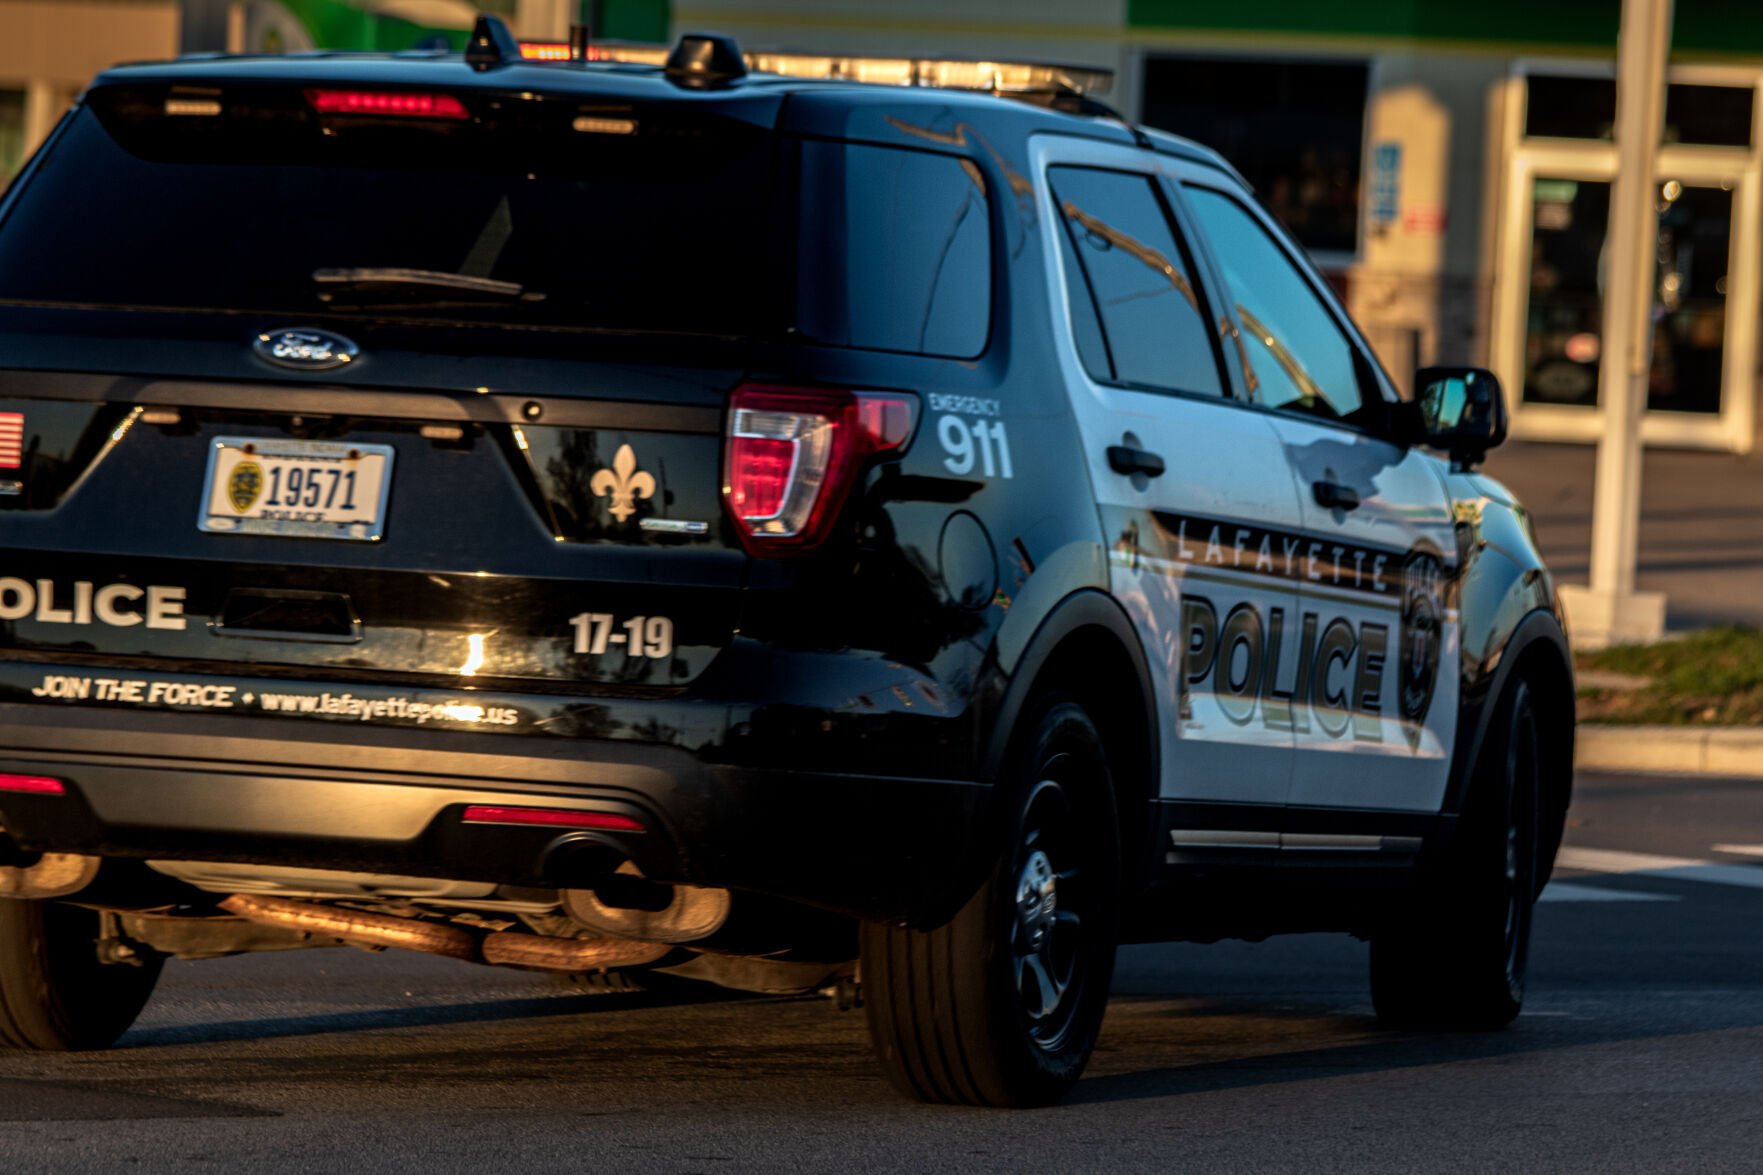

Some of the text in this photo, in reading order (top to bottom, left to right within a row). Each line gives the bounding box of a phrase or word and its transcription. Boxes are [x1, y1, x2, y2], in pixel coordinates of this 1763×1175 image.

[272, 331, 334, 360] Ford
[937, 414, 1013, 479] 911
[265, 466, 357, 511] 19571
[1177, 519, 1388, 593] LAFAYETTE
[0, 576, 188, 631] OLICE
[568, 611, 674, 659] 17-19
[1178, 592, 1389, 744] POLICE
[31, 675, 519, 726] JOIN THE FORCE www.lafayettepolie.us
